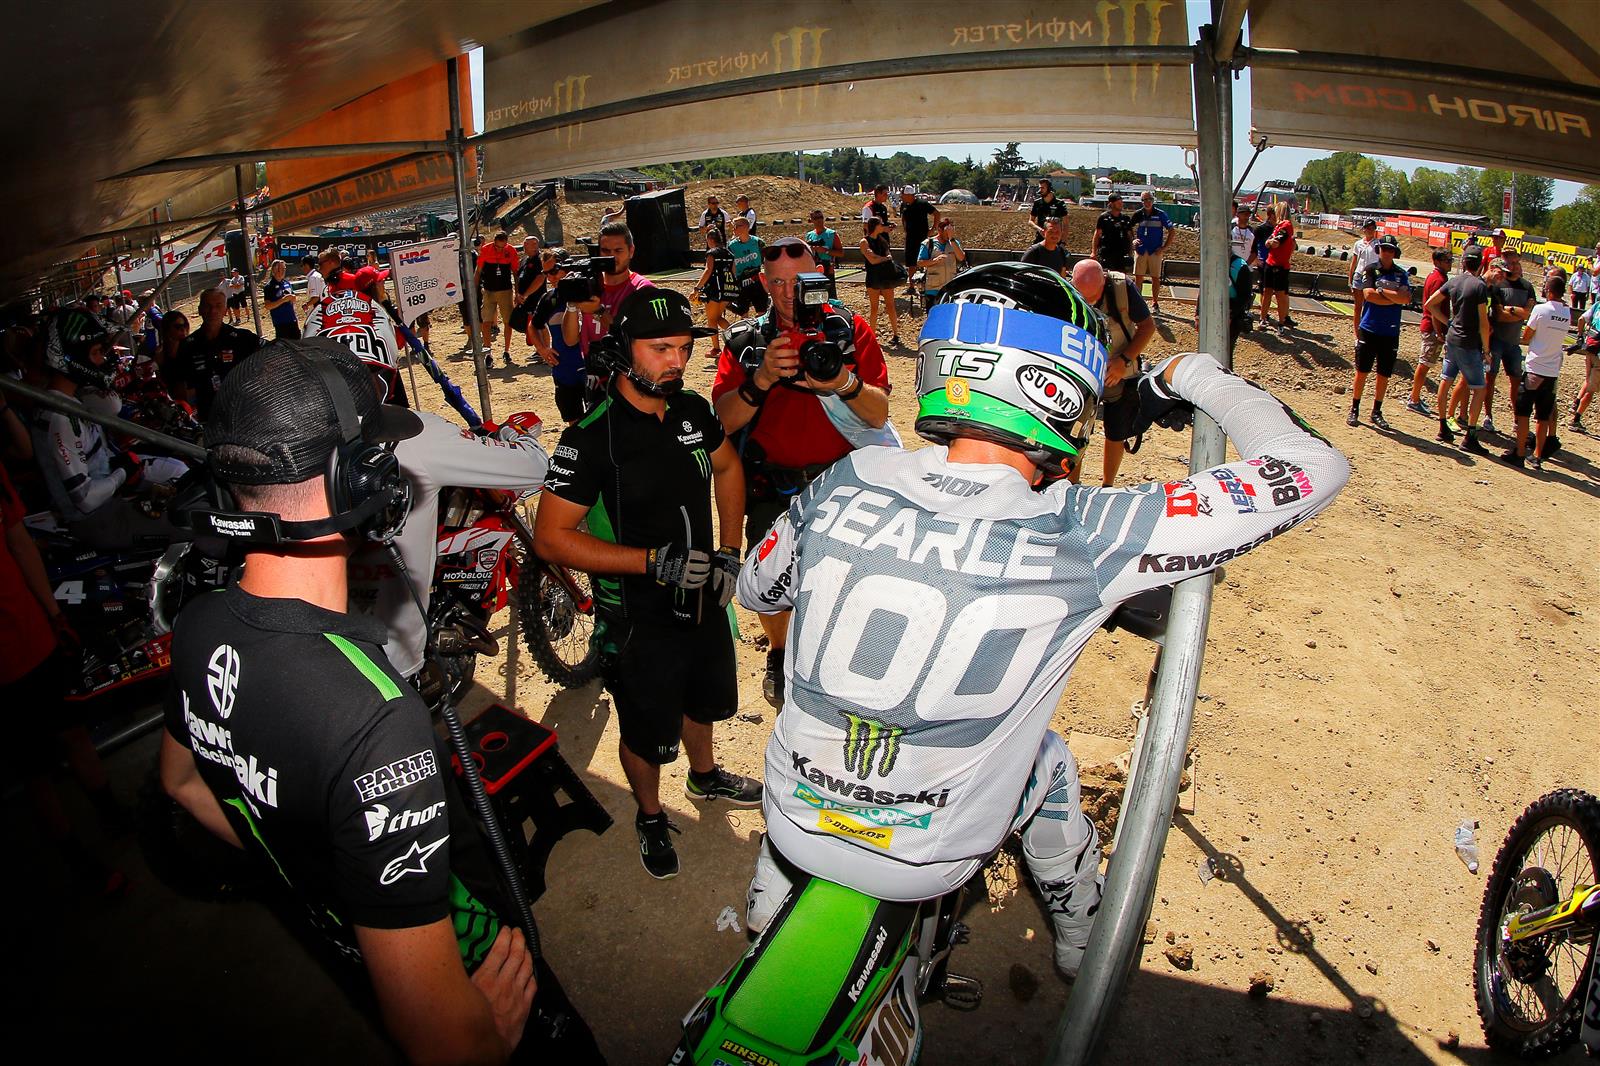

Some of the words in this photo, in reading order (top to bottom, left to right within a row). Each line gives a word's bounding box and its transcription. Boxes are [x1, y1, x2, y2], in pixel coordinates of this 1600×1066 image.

[280, 242, 319, 251] GoPro
[328, 242, 367, 251] GoPro
[377, 239, 413, 248] GoPro
[1521, 241, 1545, 256] THOR
[399, 248, 431, 267] HRC
[734, 252, 758, 264] PHOTO
[403, 278, 439, 295] BOGERS
[346, 299, 369, 312] DANCE
[406, 293, 426, 307] 189
[1551, 315, 1569, 323] STAFF
[936, 347, 1003, 381] TS
[210, 515, 256, 530] Kawasaki
[216, 527, 235, 537] Racing
[809, 485, 1063, 580] SEARLE
[443, 570, 494, 580] MOTOBLOUZ
[53, 580, 88, 605] 4
[794, 555, 1070, 723] 100
[354, 749, 434, 792] PARTS
[792, 750, 951, 808] Kawasaki
[362, 764, 437, 802] EUROPE
[831, 820, 887, 841] DUNLOP
[848, 926, 889, 1003] Kawasaki
[721, 1040, 780, 1066] HINSON
